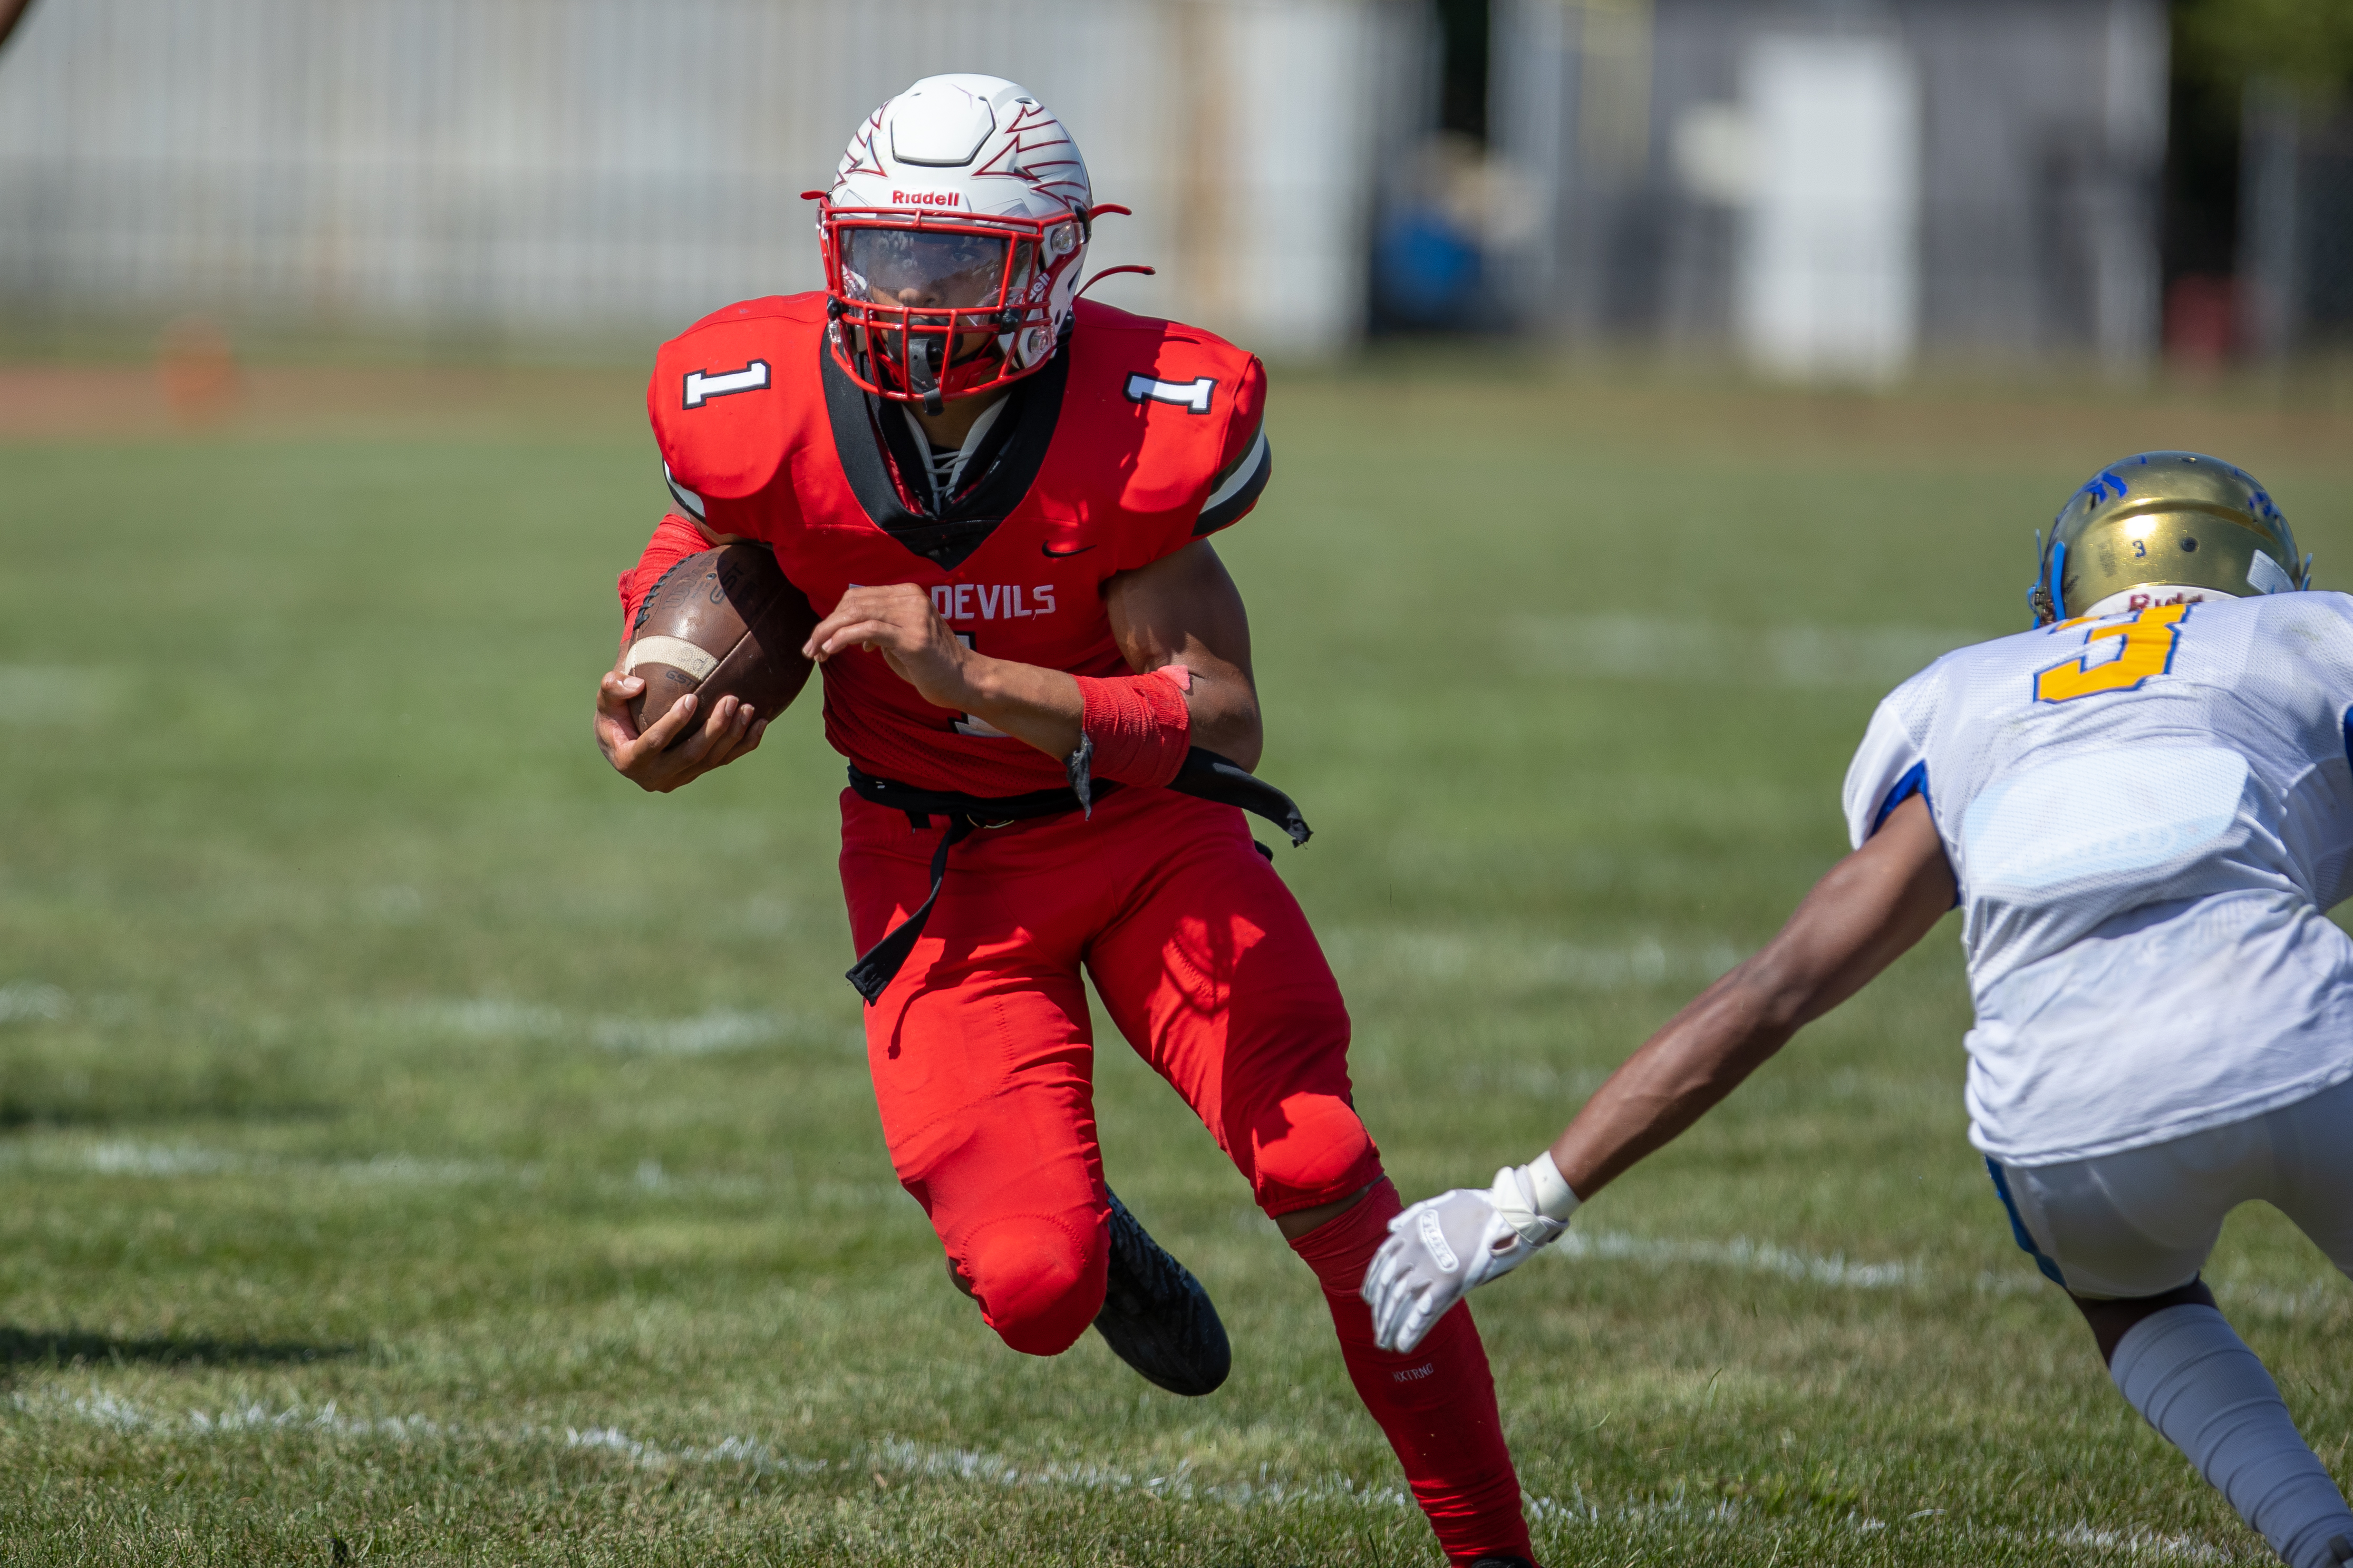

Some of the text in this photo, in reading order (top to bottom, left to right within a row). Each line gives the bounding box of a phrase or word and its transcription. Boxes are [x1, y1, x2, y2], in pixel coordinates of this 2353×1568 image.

[892, 190, 960, 207] Riddell
[682, 358, 771, 410] 1
[1126, 372, 1217, 414] 1
[2132, 539, 2147, 558] 3
[709, 561, 745, 605] GST
[931, 583, 1056, 620] DEVILS
[2033, 602, 2199, 704] 3
[665, 670, 698, 687] GST
